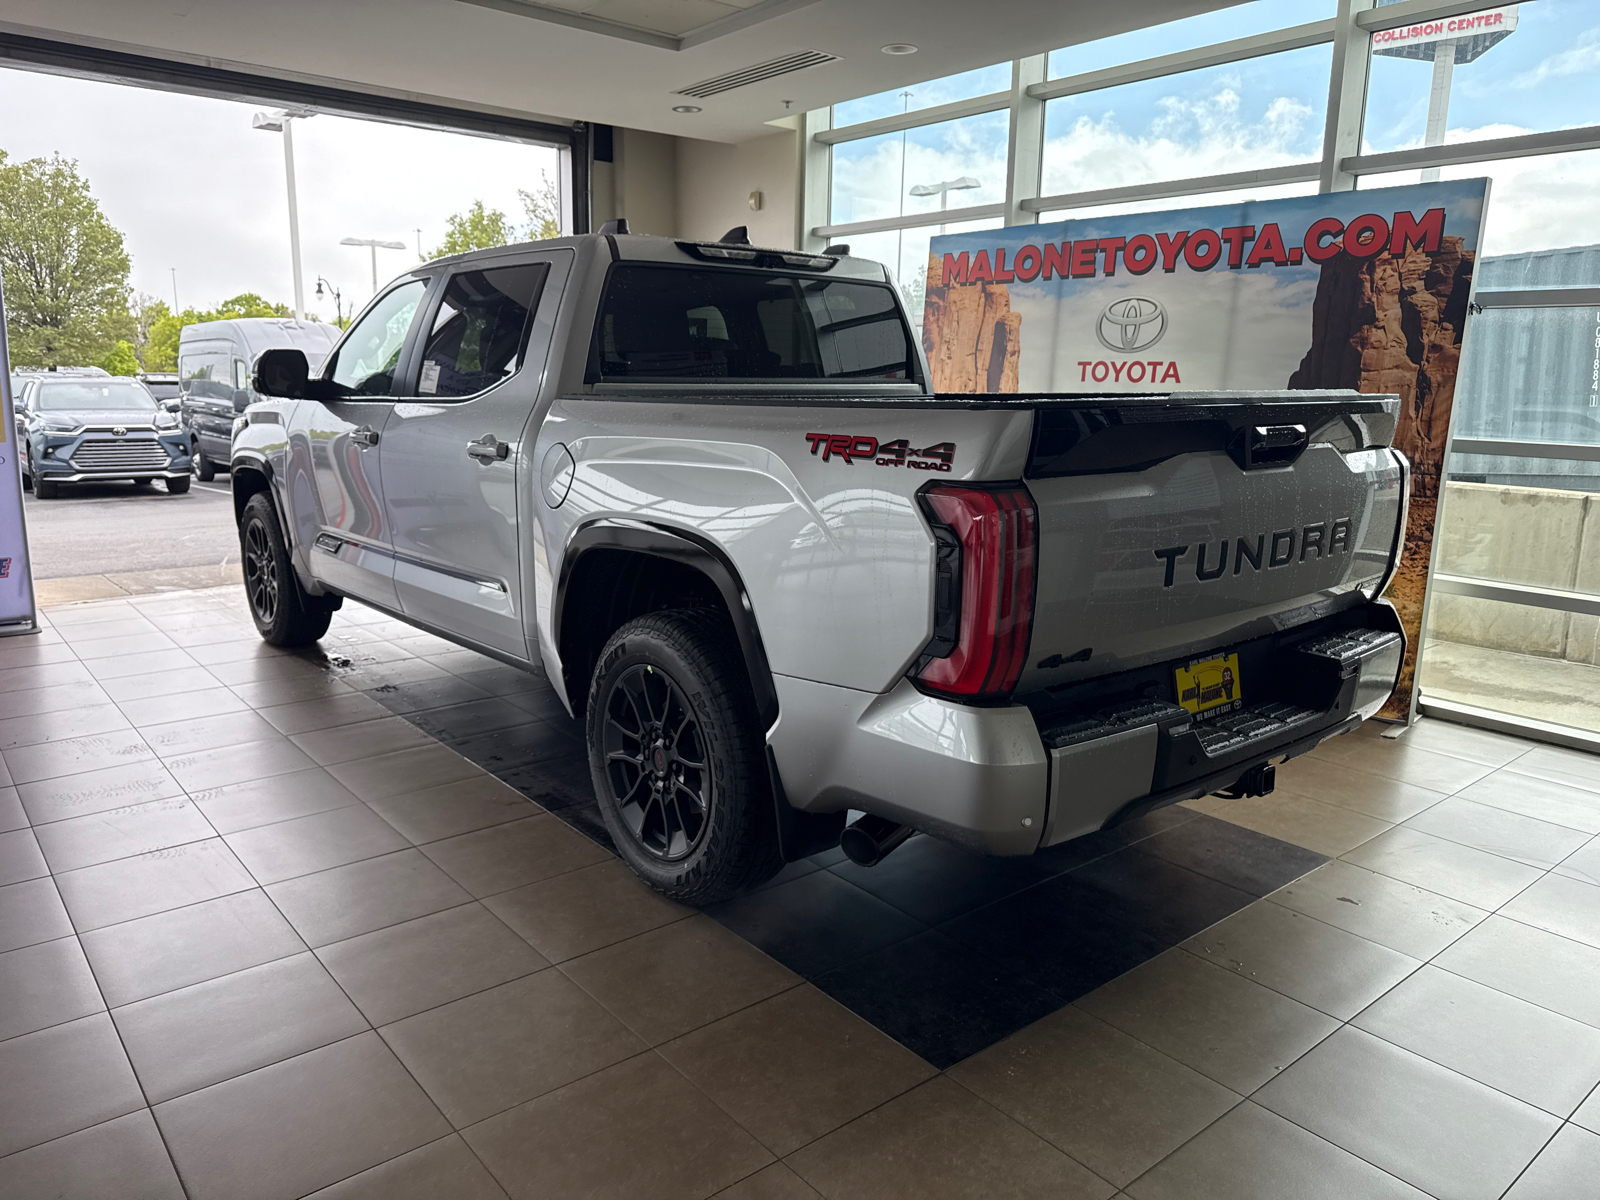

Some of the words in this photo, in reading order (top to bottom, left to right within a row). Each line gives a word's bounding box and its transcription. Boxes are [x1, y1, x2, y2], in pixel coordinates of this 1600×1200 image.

[1373, 22, 1443, 43] COLLISION
[1447, 12, 1503, 32] CENTER
[941, 208, 1446, 289] MALONETOYOTA.COM
[1077, 360, 1182, 385] TOYOTA
[805, 432, 879, 466] TRD
[877, 438, 957, 465] 4x4
[875, 457, 906, 469] OFF
[906, 460, 953, 473] ROAD
[1152, 516, 1351, 588] TUNDRA
[1224, 671, 1230, 680] 32
[1204, 709, 1215, 719] MAKE
[1220, 704, 1231, 713] EASY
